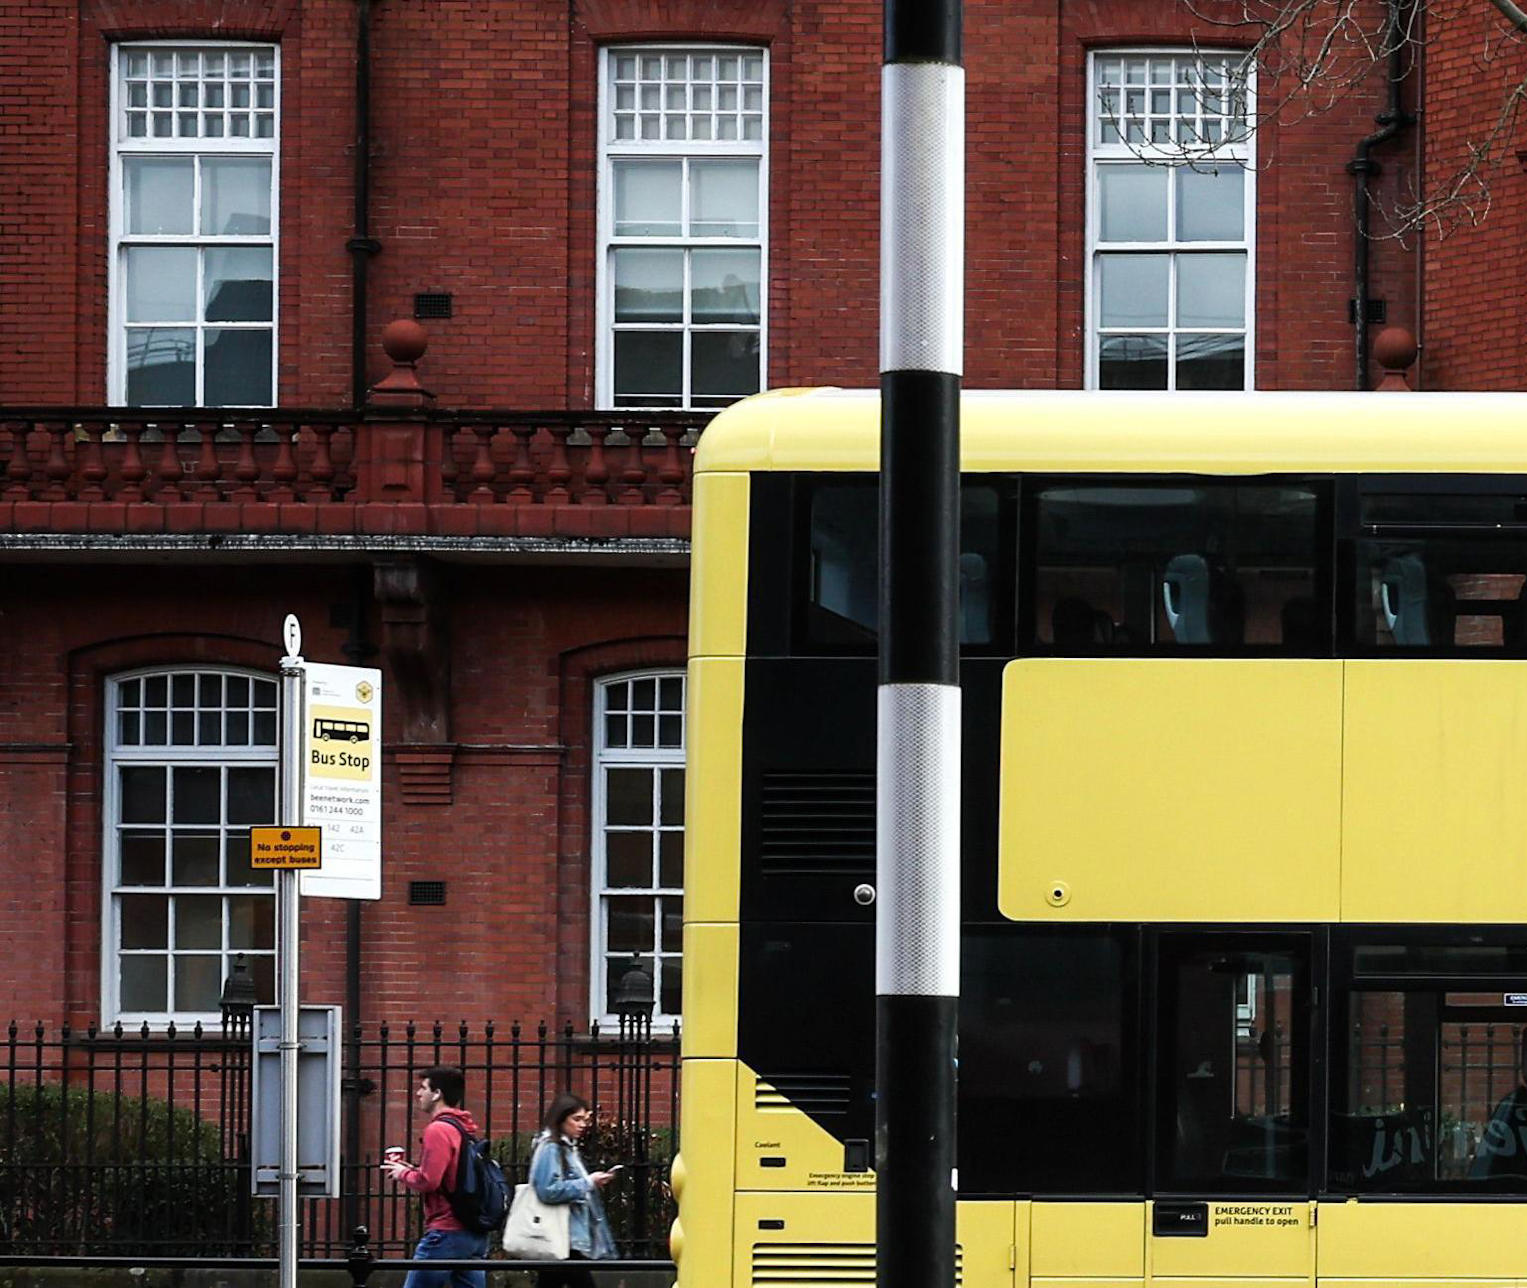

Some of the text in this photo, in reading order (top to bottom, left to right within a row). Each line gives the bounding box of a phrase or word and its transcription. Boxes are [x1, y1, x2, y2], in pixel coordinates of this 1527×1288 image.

[311, 749, 370, 772] Bus Stop
[257, 843, 315, 853] No stopping
[254, 856, 317, 865] except buses
[1215, 1207, 1293, 1216] EMERGENCY EXIT
[1214, 1217, 1299, 1227] pull handle to open
